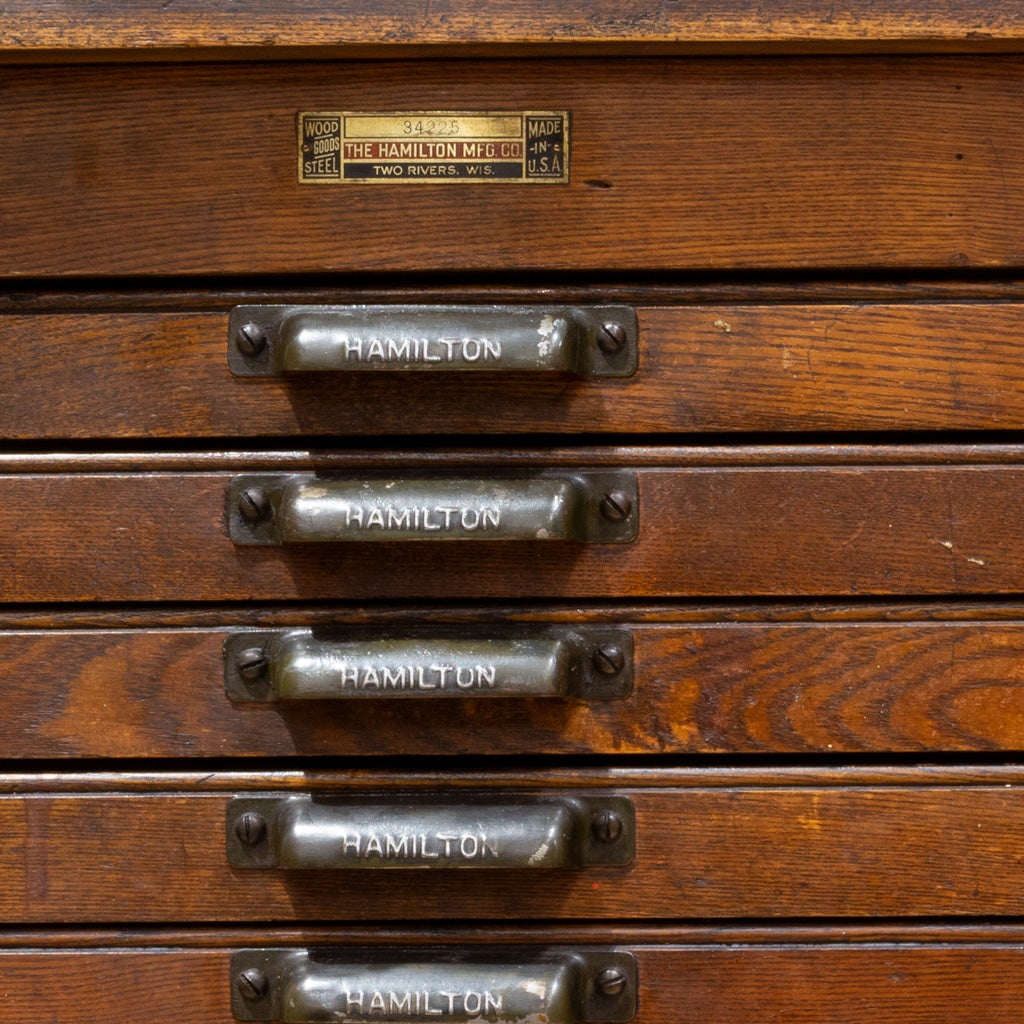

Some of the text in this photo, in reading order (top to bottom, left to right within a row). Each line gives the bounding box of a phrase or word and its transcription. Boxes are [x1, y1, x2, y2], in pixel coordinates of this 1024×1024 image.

[305, 121, 338, 137] WOOD
[404, 120, 460, 135] 34225
[529, 121, 560, 138] MADE
[314, 138, 340, 154] GOODS
[345, 143, 522, 158] THE HAMILTON MFG. CO.
[304, 158, 338, 173] STEEL
[373, 166, 495, 176] TWO RIVERS, WIS.
[344, 338, 502, 362] HAMILTON
[345, 507, 500, 531] HAMILTON
[340, 666, 496, 690] HAMILTON
[343, 835, 498, 859] HAMILTON
[345, 991, 502, 1016] HAMILTON
